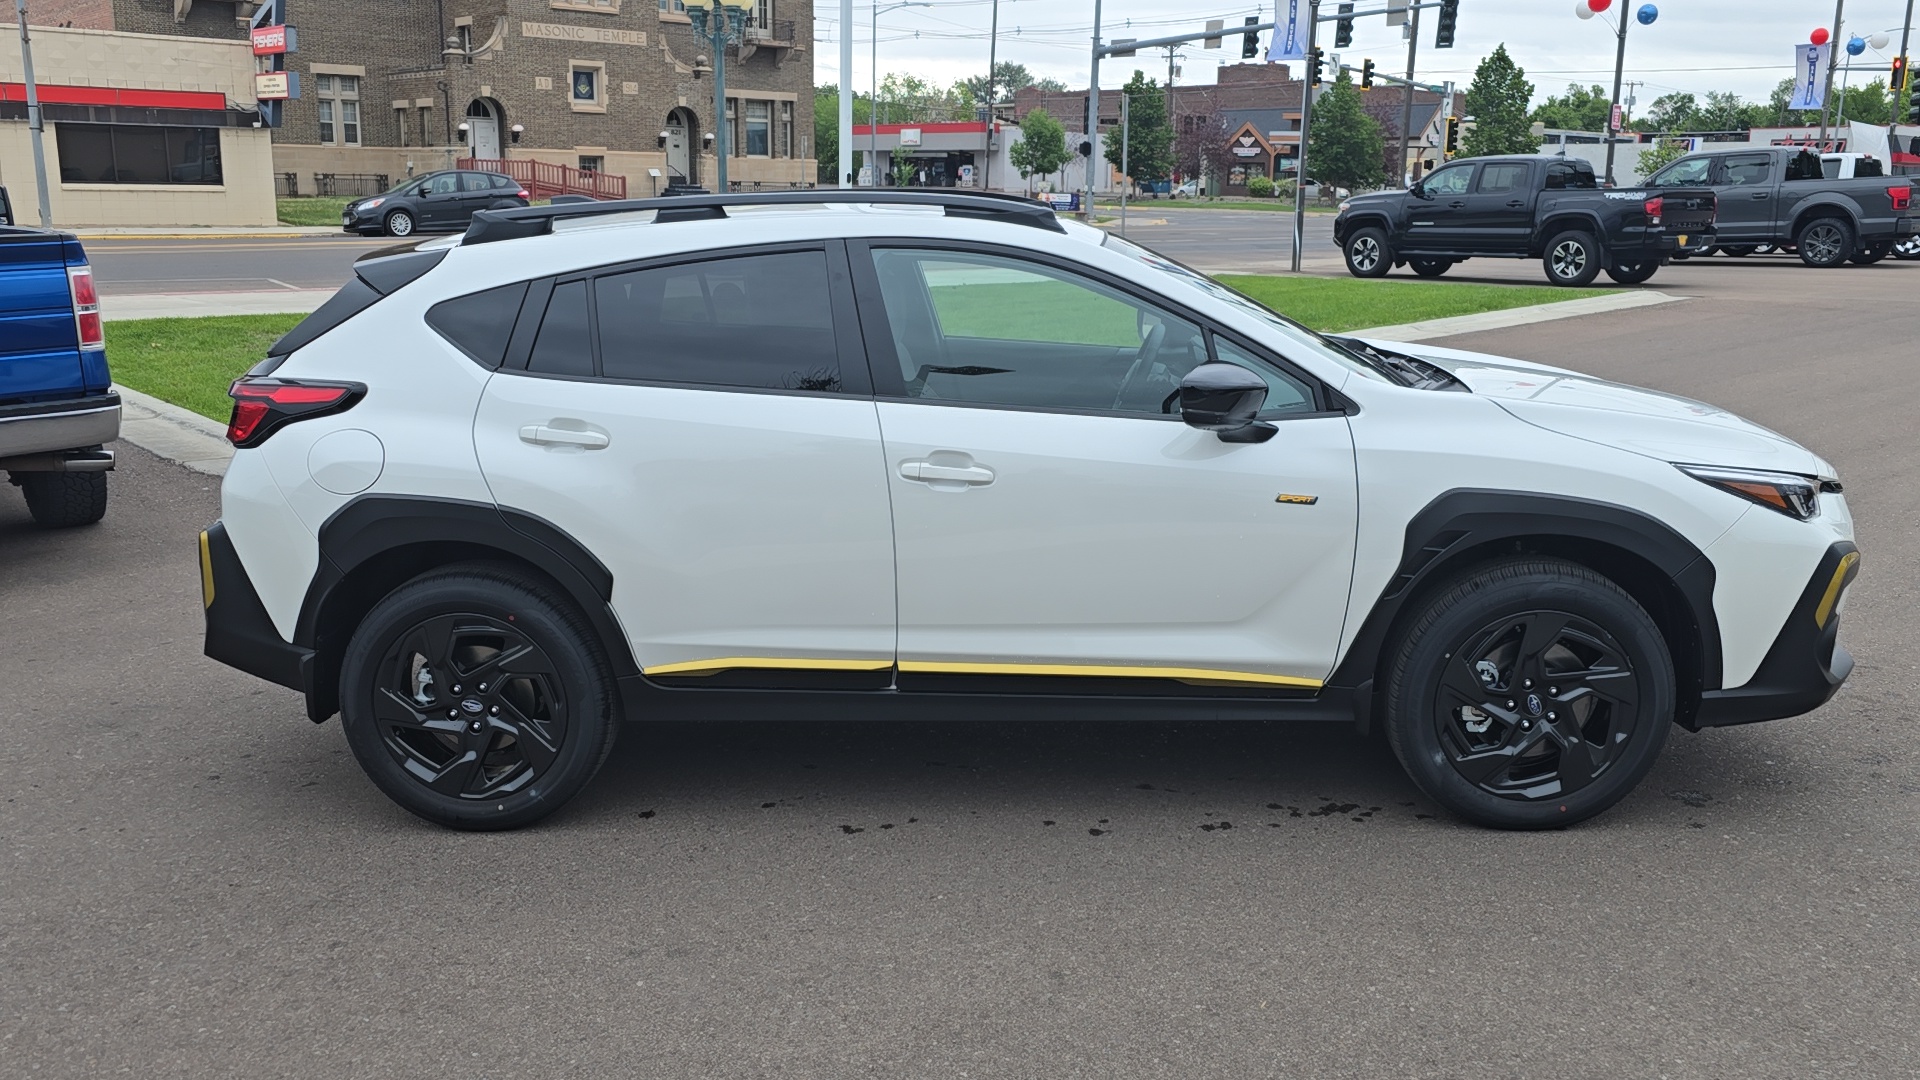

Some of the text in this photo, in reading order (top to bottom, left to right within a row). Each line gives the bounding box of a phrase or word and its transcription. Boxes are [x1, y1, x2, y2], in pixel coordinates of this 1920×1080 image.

[524, 23, 645, 44] MASONIC TEMPLE
[1287, 23, 1295, 51] EVENT
[1278, 494, 1315, 503] SPORT
